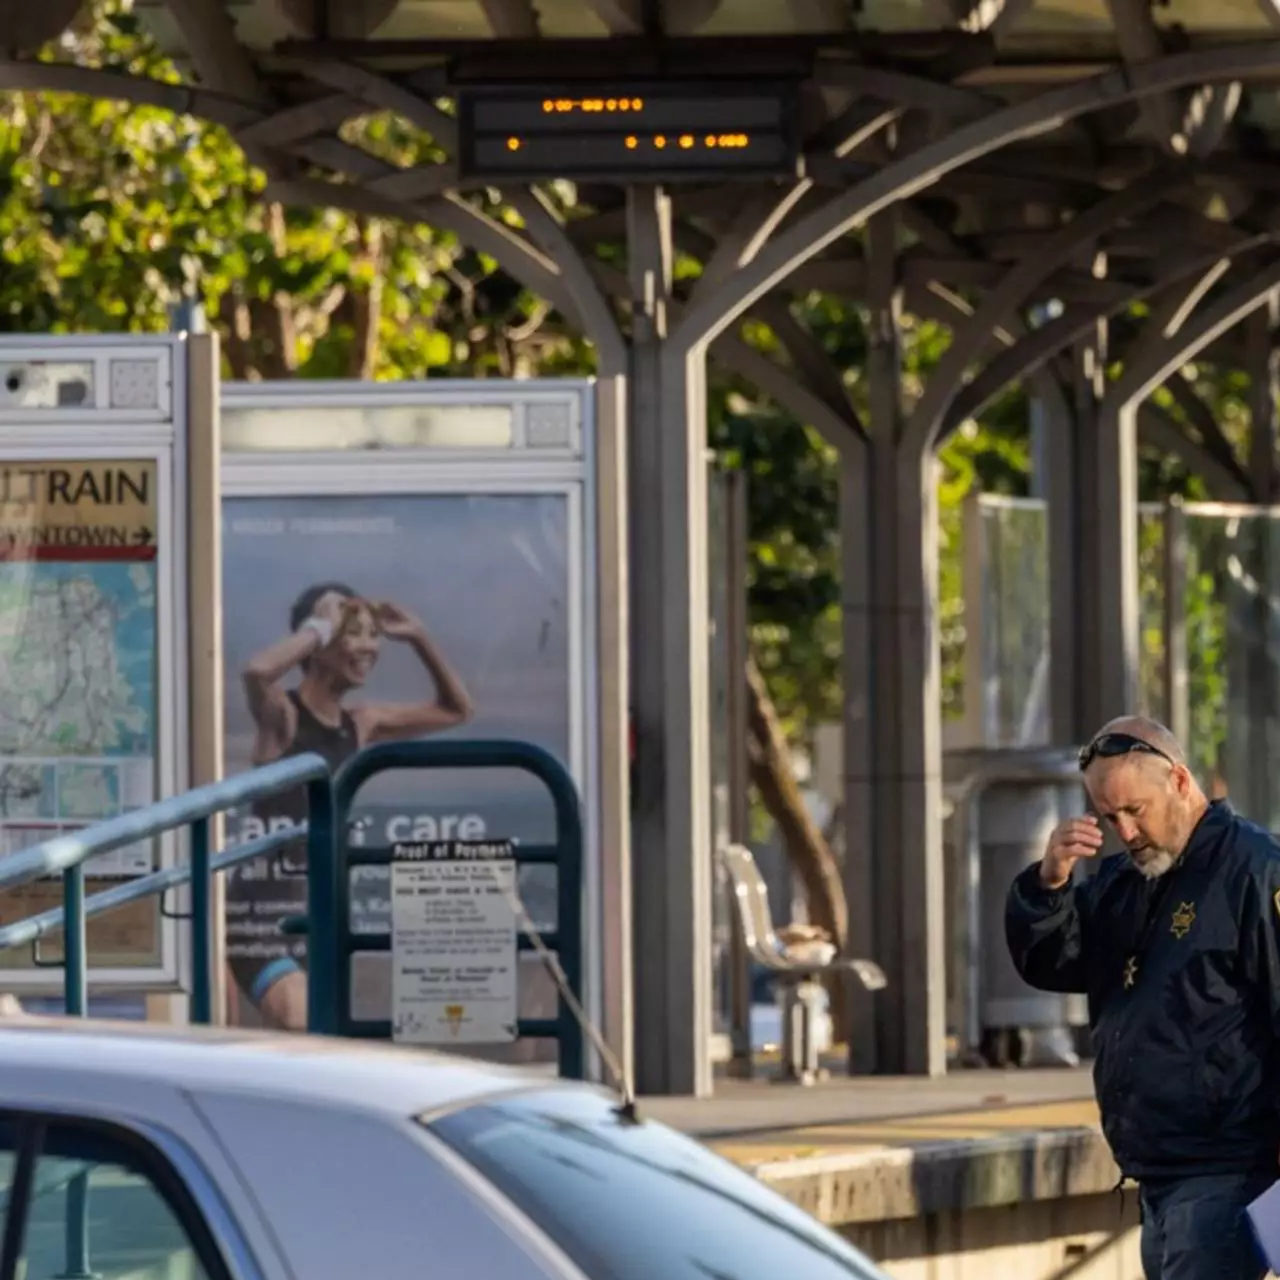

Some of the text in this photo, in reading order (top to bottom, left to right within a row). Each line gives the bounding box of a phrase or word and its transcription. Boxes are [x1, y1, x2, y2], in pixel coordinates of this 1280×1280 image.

[395, 842, 513, 859] Proof of Payment
